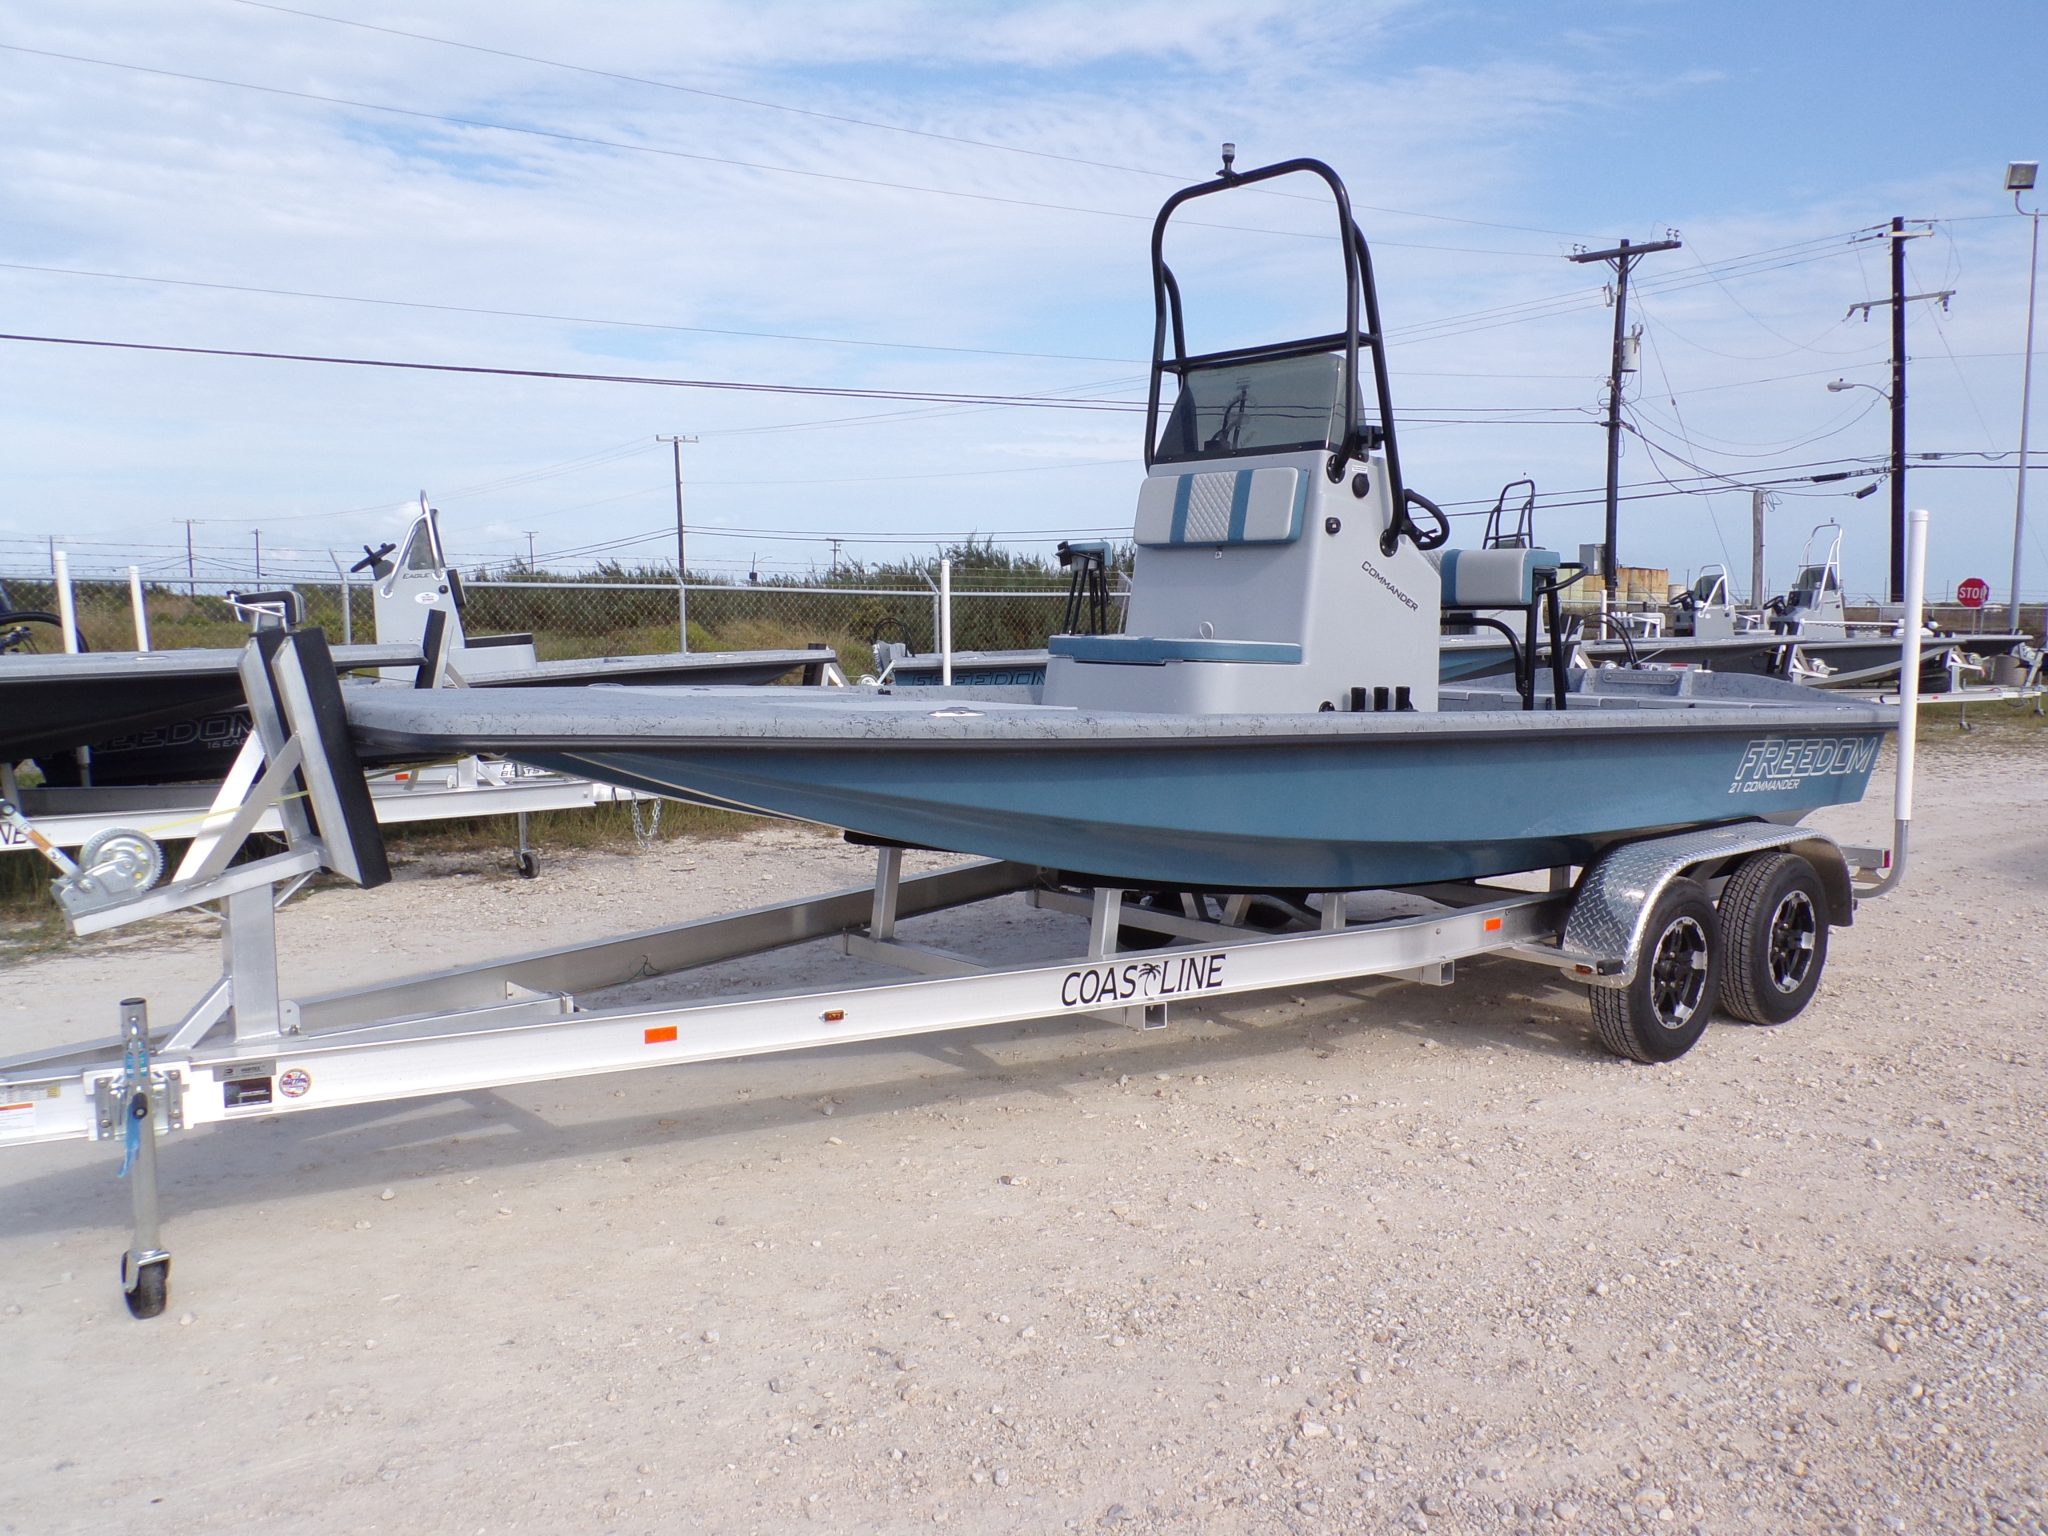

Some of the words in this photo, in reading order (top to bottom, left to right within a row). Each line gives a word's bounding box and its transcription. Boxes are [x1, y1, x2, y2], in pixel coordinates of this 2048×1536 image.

[1361, 560, 1419, 612] COMMANDER
[1958, 586, 1988, 600] STOP
[1734, 737, 1879, 780] FREEDOM
[1728, 782, 1743, 794] 21
[1743, 778, 1801, 793] COMMANDER
